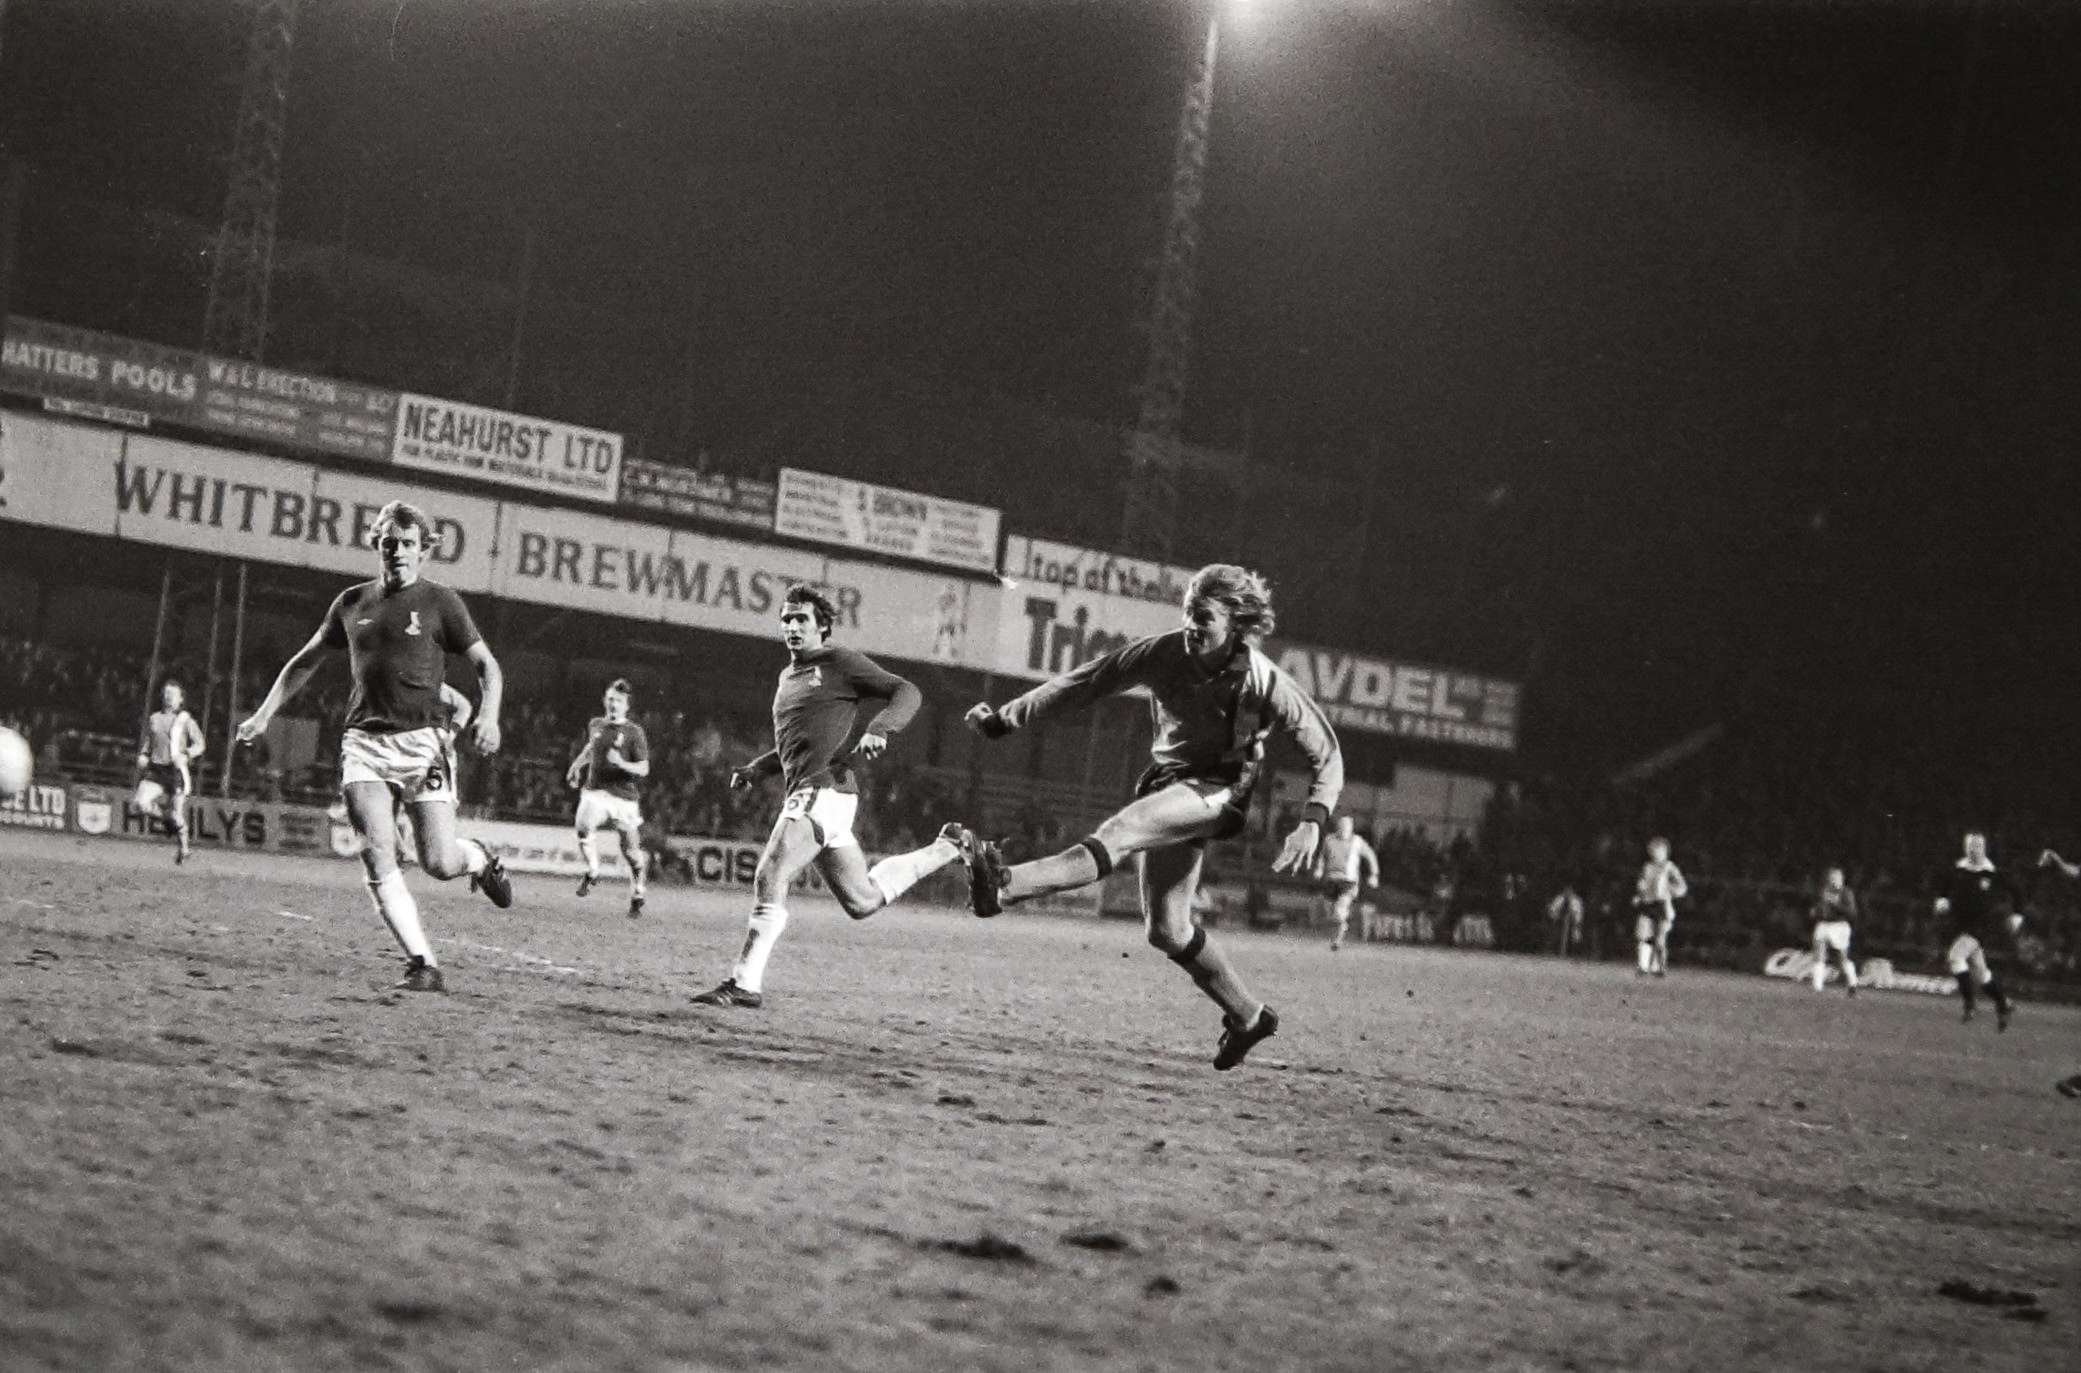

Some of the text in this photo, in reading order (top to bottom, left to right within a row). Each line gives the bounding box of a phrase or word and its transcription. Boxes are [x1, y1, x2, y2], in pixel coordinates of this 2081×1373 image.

[1, 338, 198, 402] HATTERS POOLS
[403, 402, 553, 462] NEAHURST
[564, 433, 615, 475] LTD
[113, 458, 465, 565] WHITBRED
[516, 532, 863, 629] BREWMASR
[1034, 553, 1077, 595] top
[1085, 556, 1116, 595] of
[1277, 648, 1466, 719] AVDEL
[29, 784, 66, 815] LTD
[121, 800, 266, 844] HELYS
